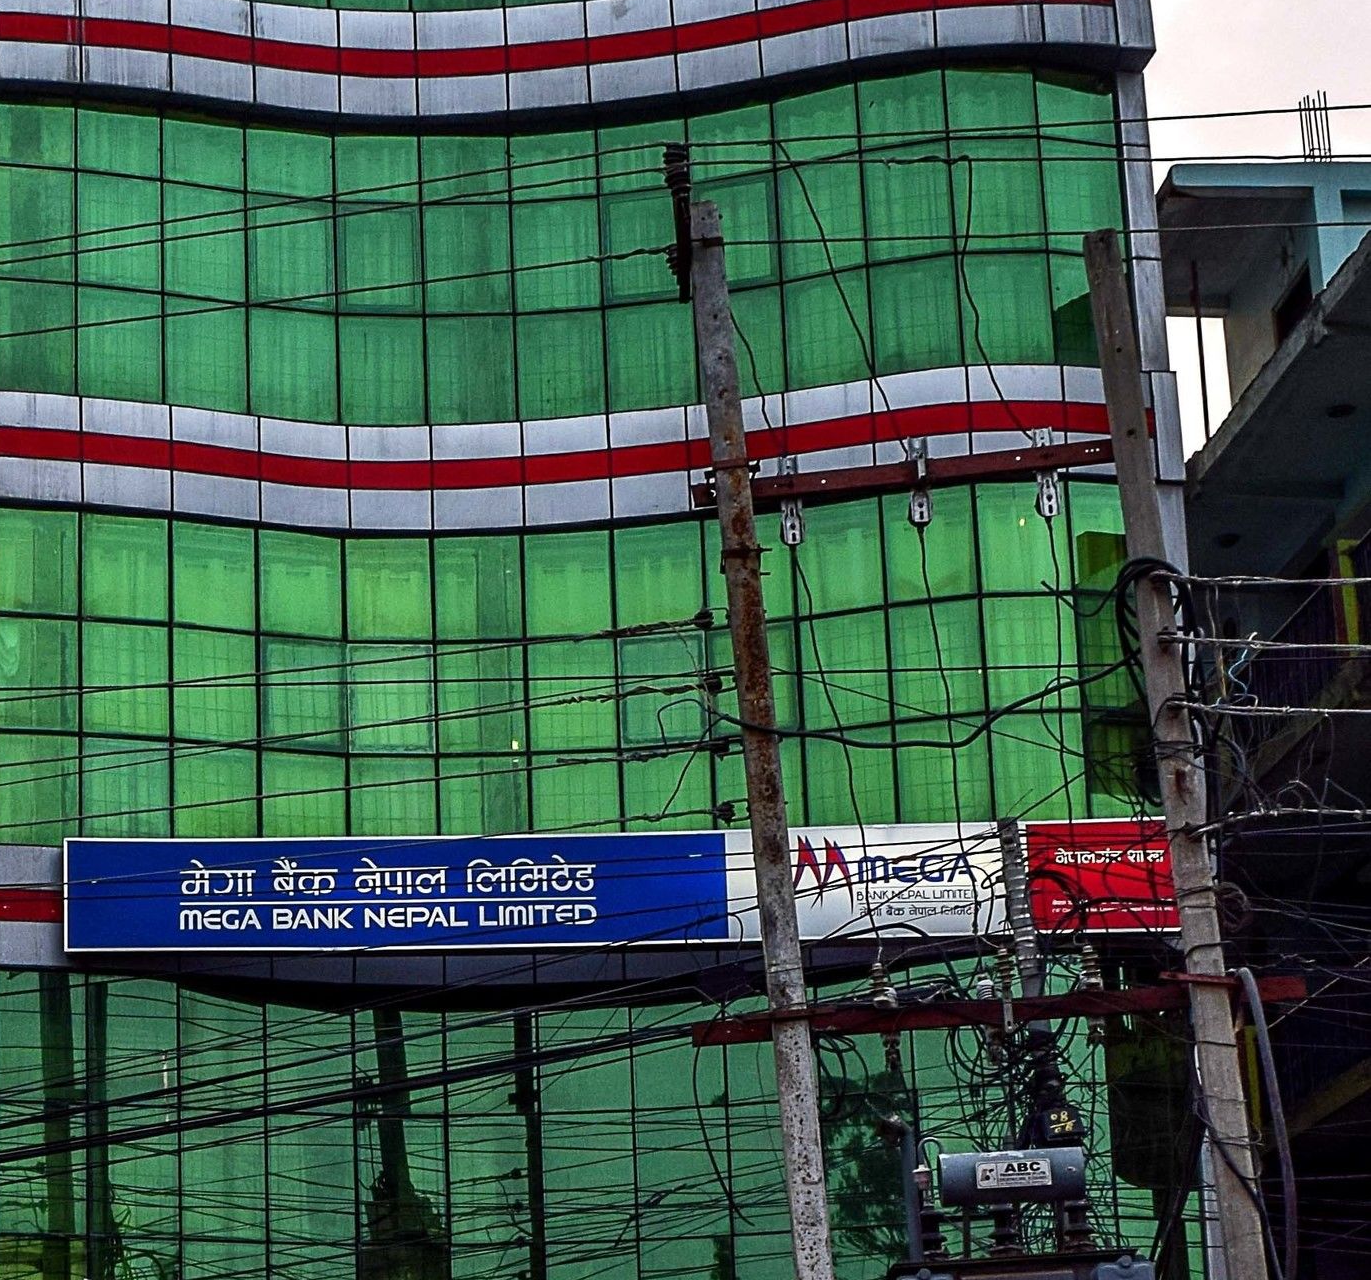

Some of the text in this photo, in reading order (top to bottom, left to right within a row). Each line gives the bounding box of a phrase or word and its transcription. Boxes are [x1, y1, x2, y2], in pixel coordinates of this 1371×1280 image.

[179, 854, 597, 898] मेगा बैंक नेपाल लिमिटेड
[179, 903, 598, 932] MEGA BANK NEPAL LIMITED
[1004, 1162, 1041, 1173] ABC
